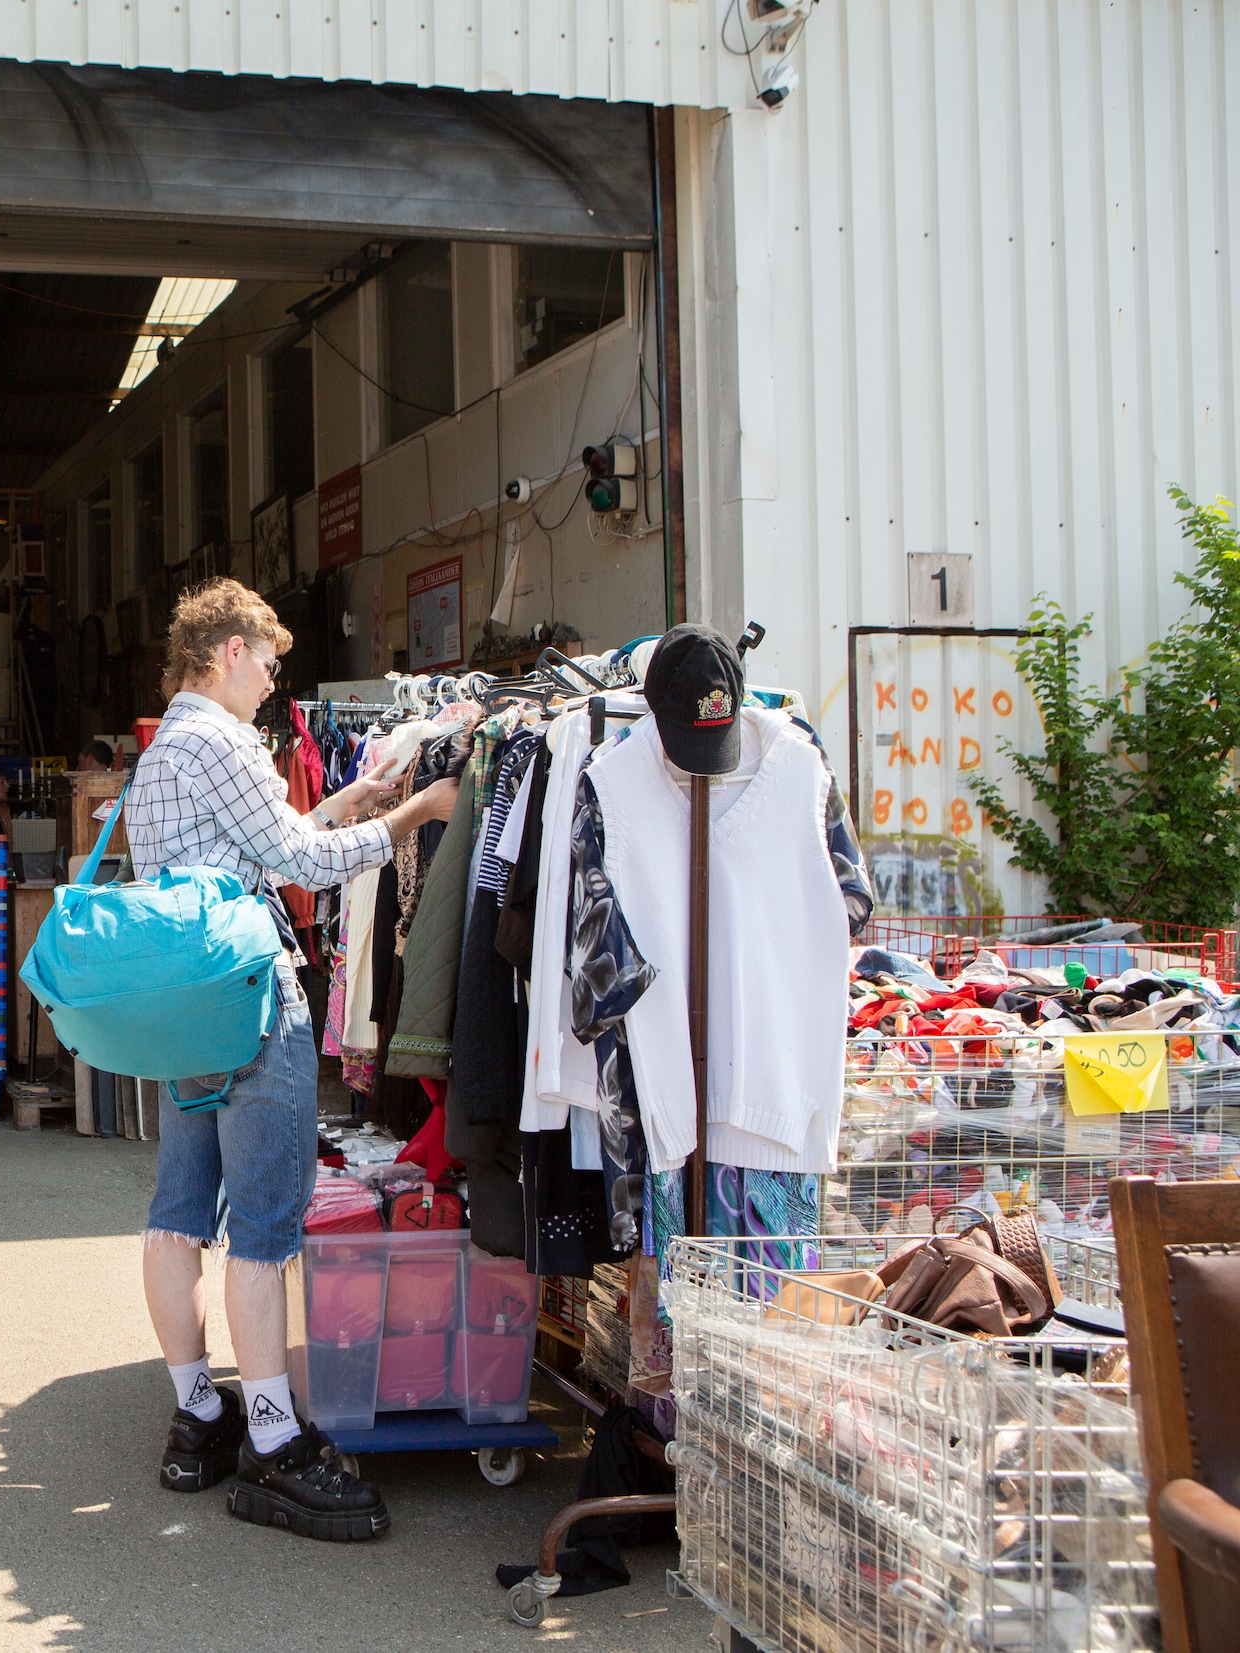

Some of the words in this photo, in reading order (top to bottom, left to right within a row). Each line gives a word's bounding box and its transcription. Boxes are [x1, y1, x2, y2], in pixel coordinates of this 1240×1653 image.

[931, 567, 947, 611] 1
[875, 681, 1013, 718] KOKO
[888, 731, 981, 770] AND
[249, 1415, 291, 1427] GAASTRA
